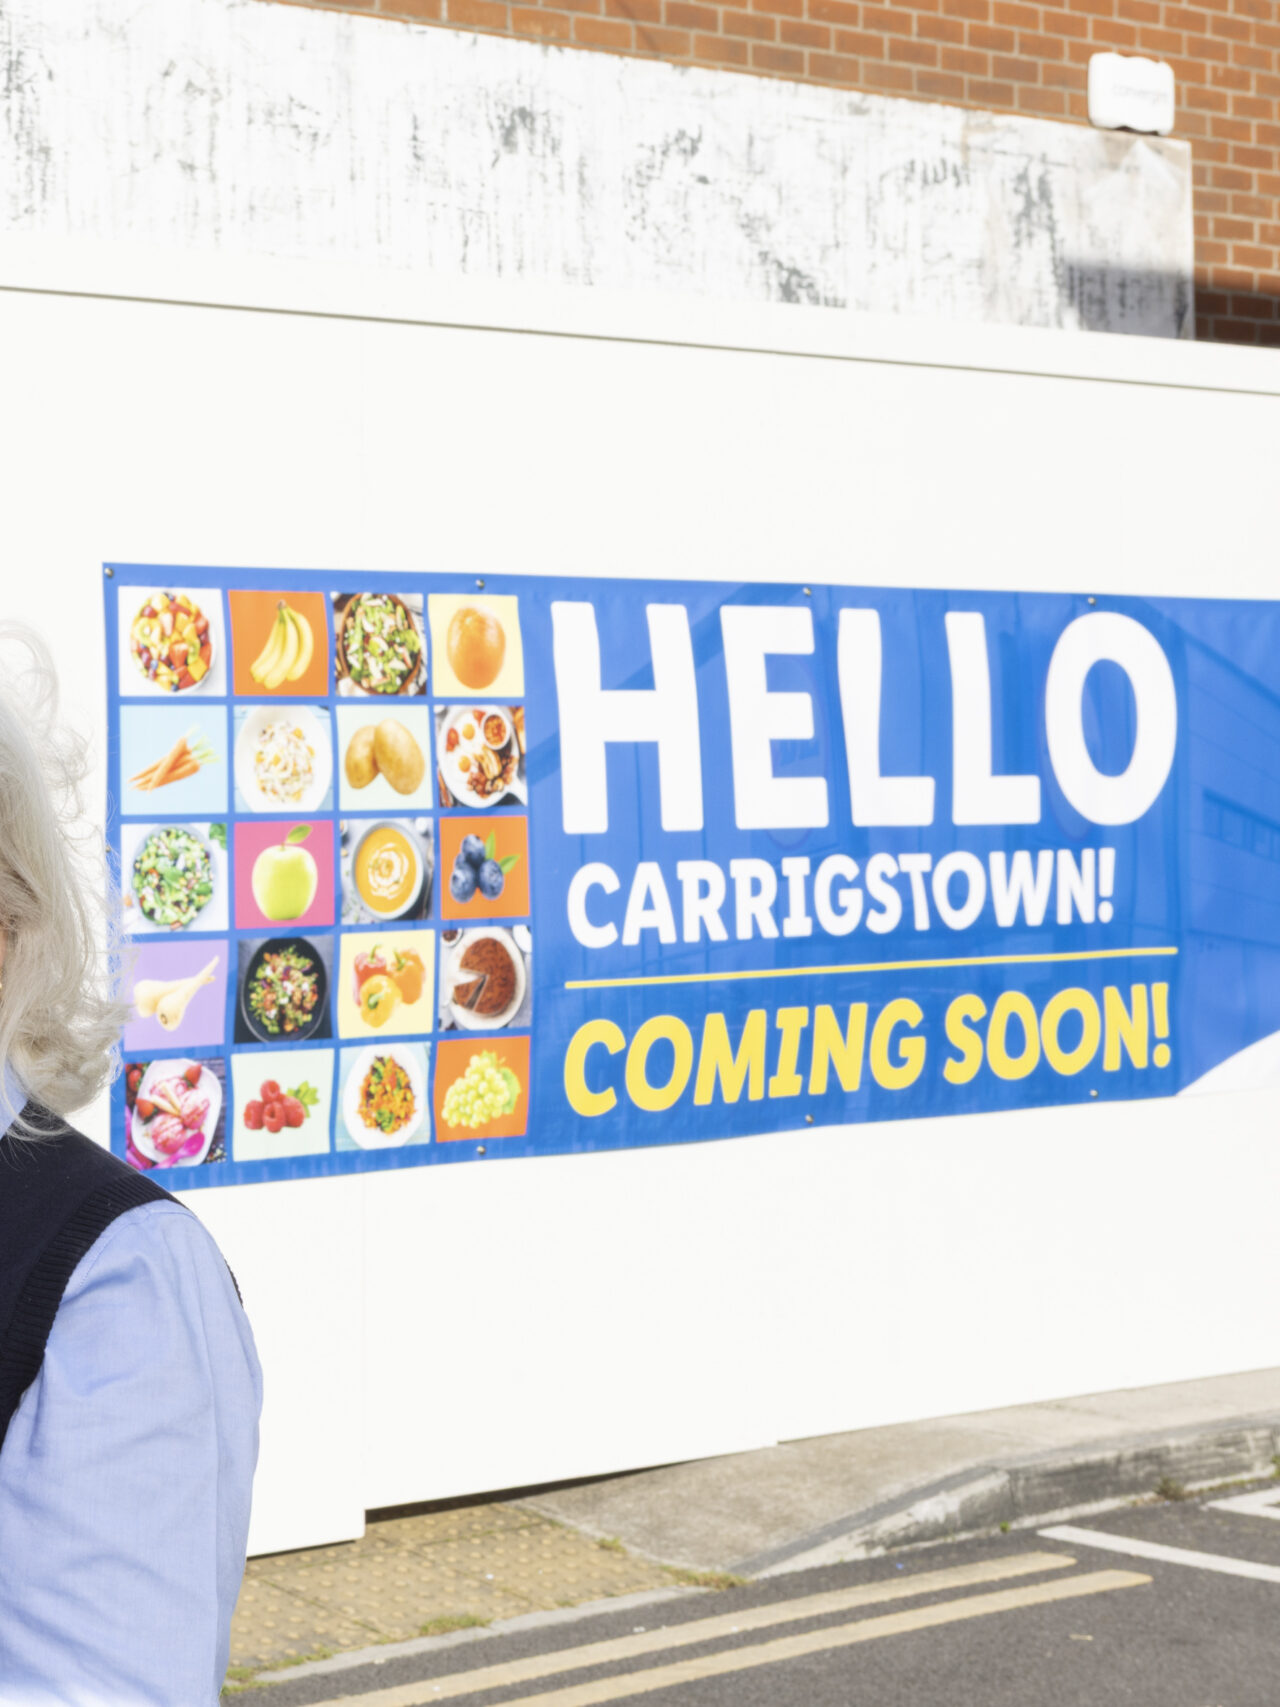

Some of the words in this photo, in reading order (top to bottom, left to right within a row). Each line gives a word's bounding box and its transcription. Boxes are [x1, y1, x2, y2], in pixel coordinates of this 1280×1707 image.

[551, 601, 1177, 835] HELLO
[567, 847, 1116, 949] CARRIGSTOWN!
[564, 999, 927, 1117] COMING
[943, 983, 1171, 1085] SOON!
